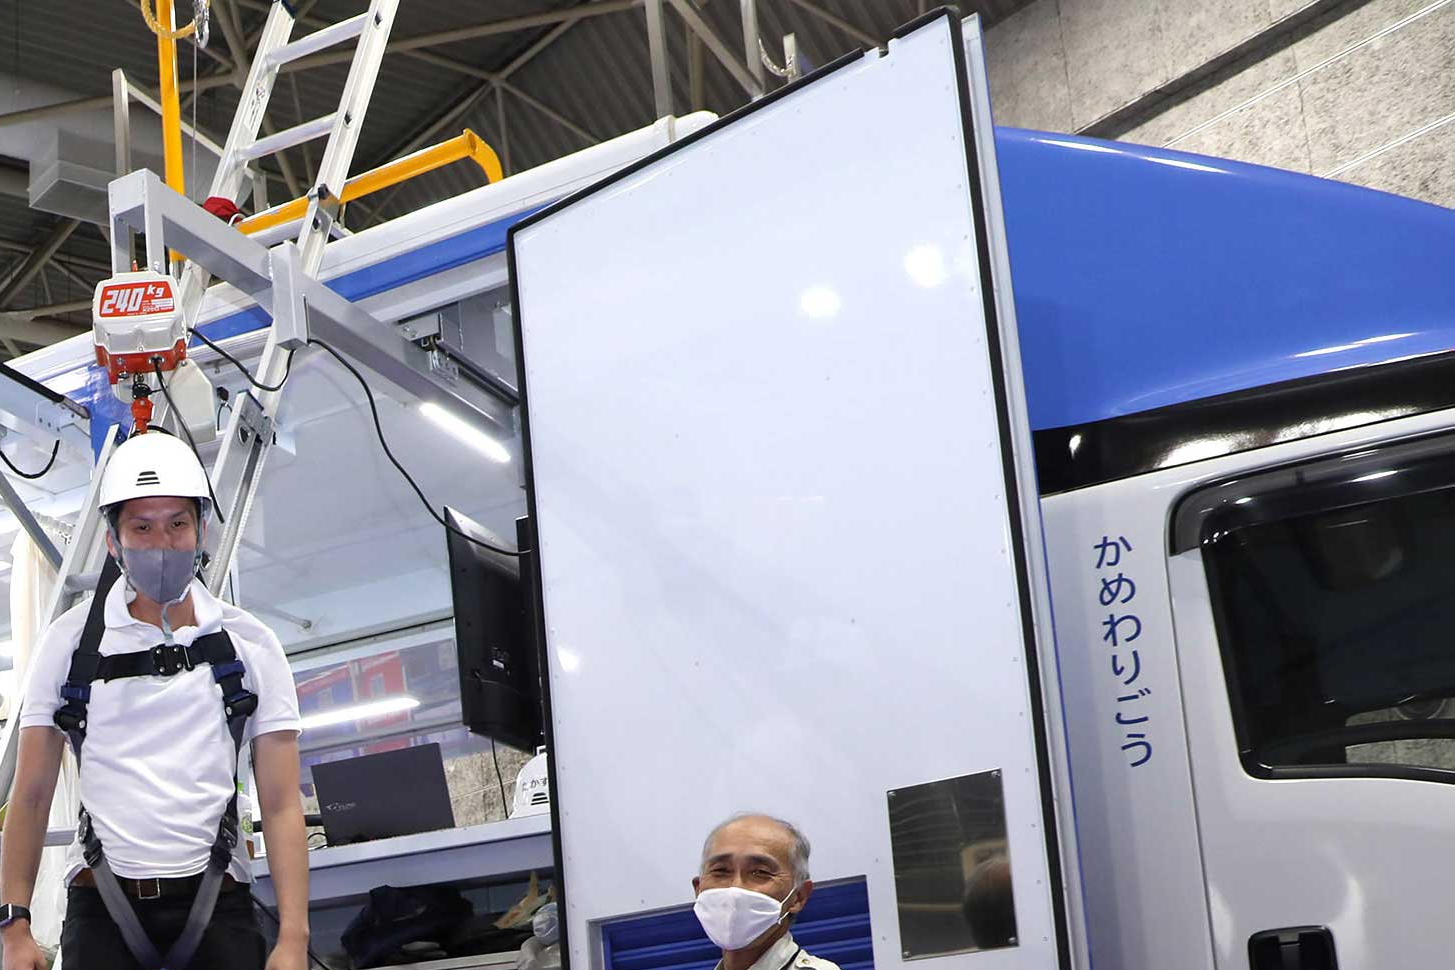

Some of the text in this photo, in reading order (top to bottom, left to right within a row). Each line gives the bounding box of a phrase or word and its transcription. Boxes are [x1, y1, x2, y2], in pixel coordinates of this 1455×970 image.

[102, 288, 145, 313] 240
[147, 284, 164, 297] kg
[1093, 535, 1153, 768] かめわりごう
